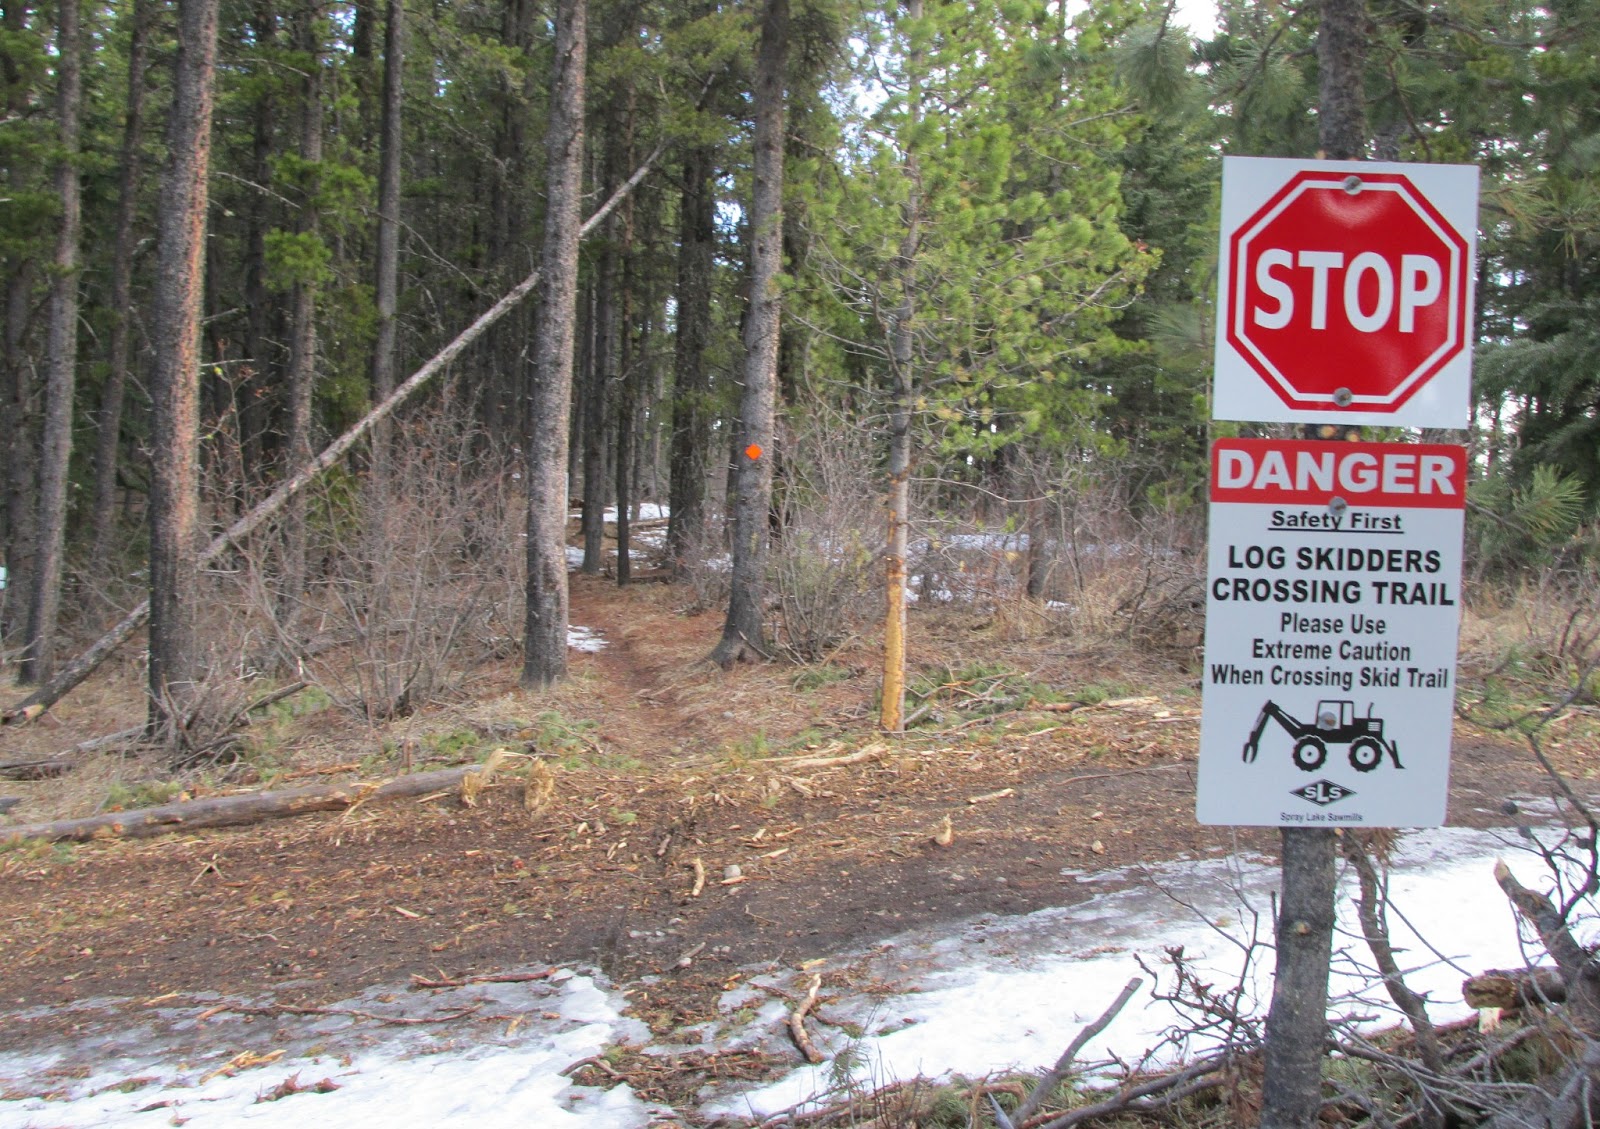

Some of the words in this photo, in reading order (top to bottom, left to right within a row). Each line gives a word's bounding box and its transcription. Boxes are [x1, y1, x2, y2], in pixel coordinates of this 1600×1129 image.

[1254, 248, 1442, 333] STOP
[1217, 449, 1456, 495] DANGER
[1271, 511, 1342, 530] Safety
[1351, 513, 1402, 529] First
[1228, 545, 1286, 569] LOG
[1296, 547, 1441, 573] SKIDDERS
[1212, 577, 1361, 603] CROSSING
[1372, 581, 1455, 606] TRAIL
[1281, 612, 1344, 633] Please
[1350, 614, 1386, 634] Use
[1252, 638, 1332, 660] Extreme
[1339, 640, 1411, 661] Caution
[1211, 664, 1263, 685] When
[1271, 665, 1353, 691] Crossing
[1360, 666, 1399, 687] Skid
[1407, 668, 1448, 689] Trail
[1304, 783, 1342, 802] SLS
[1280, 812, 1304, 822] Spray
[1306, 812, 1325, 821] Lake
[1328, 812, 1363, 821] Sawmills
